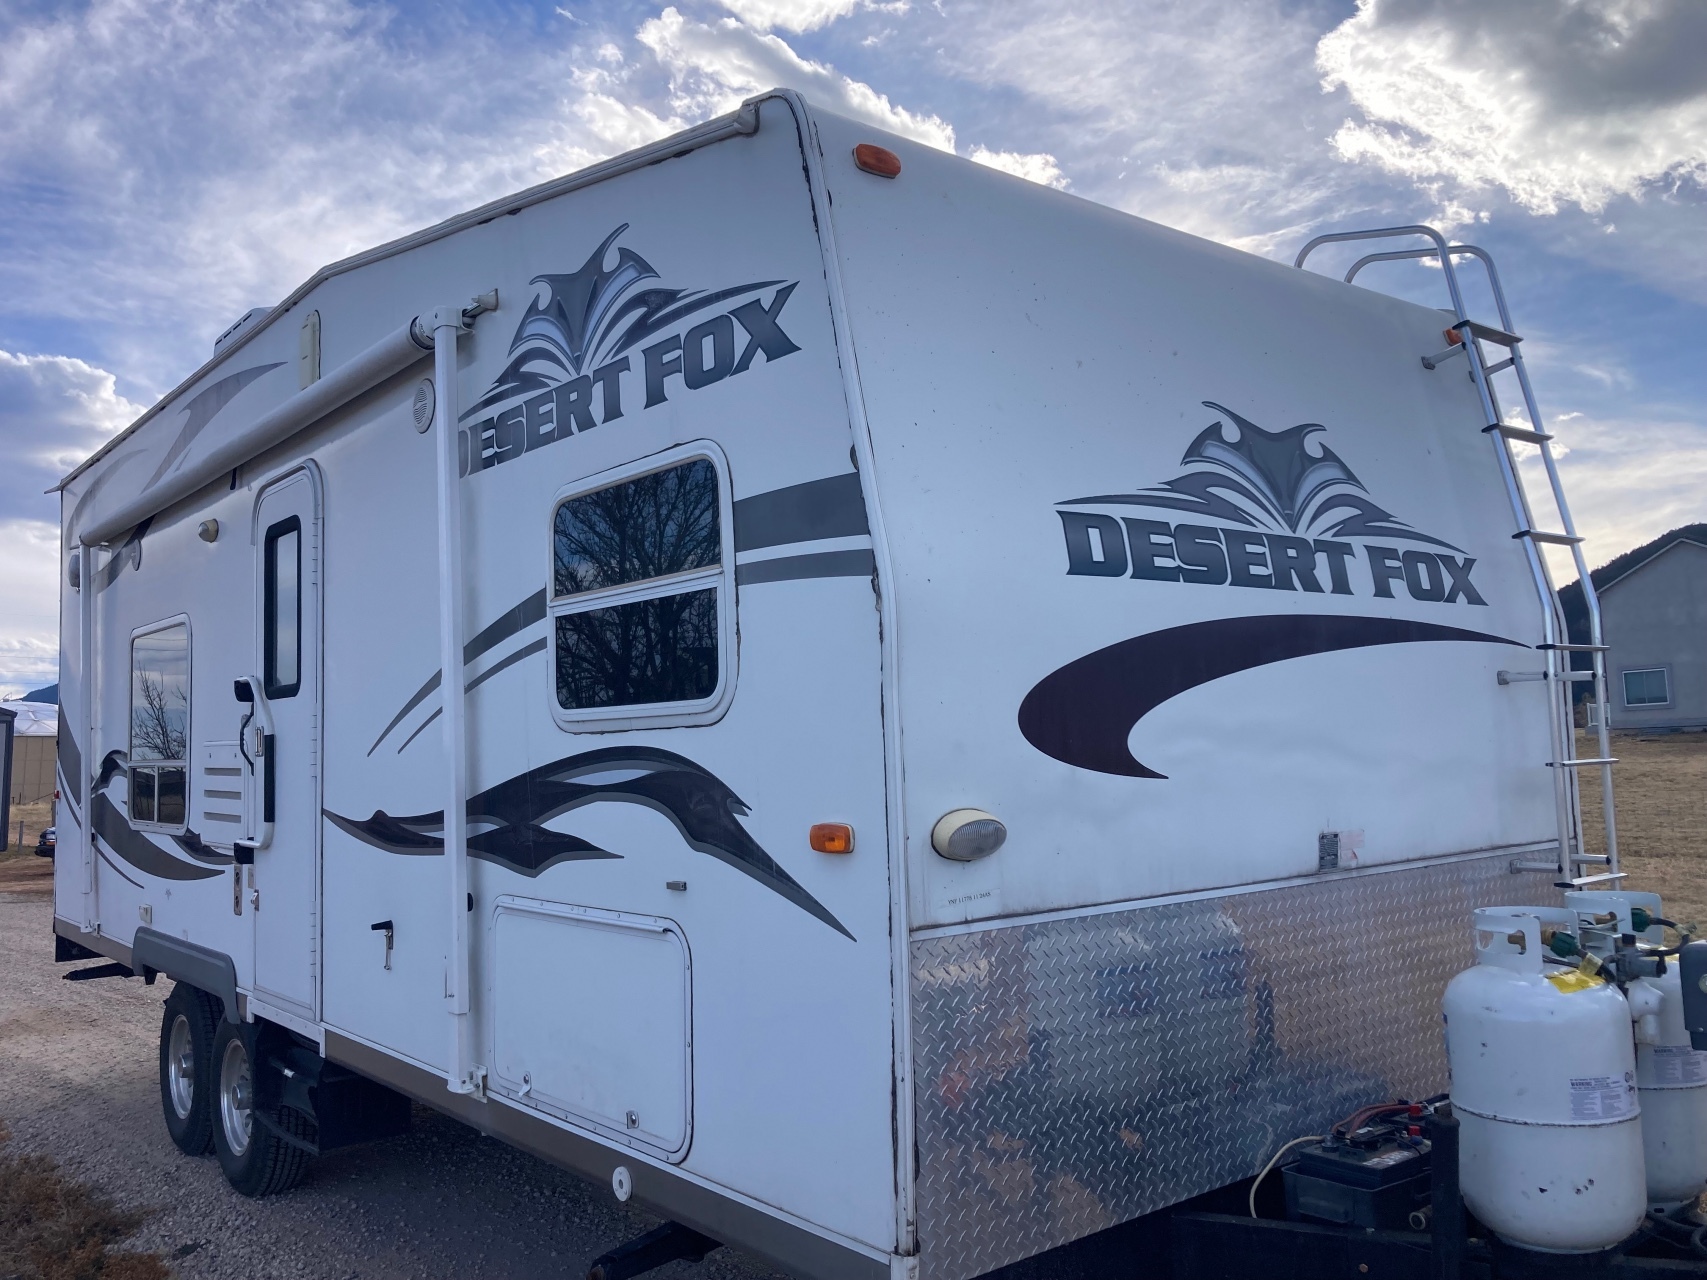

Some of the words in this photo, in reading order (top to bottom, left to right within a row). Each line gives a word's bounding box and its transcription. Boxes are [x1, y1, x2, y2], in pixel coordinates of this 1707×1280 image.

[641, 280, 803, 409] FOX
[1055, 509, 1357, 596] DESERT
[1363, 544, 1490, 607] FOX
